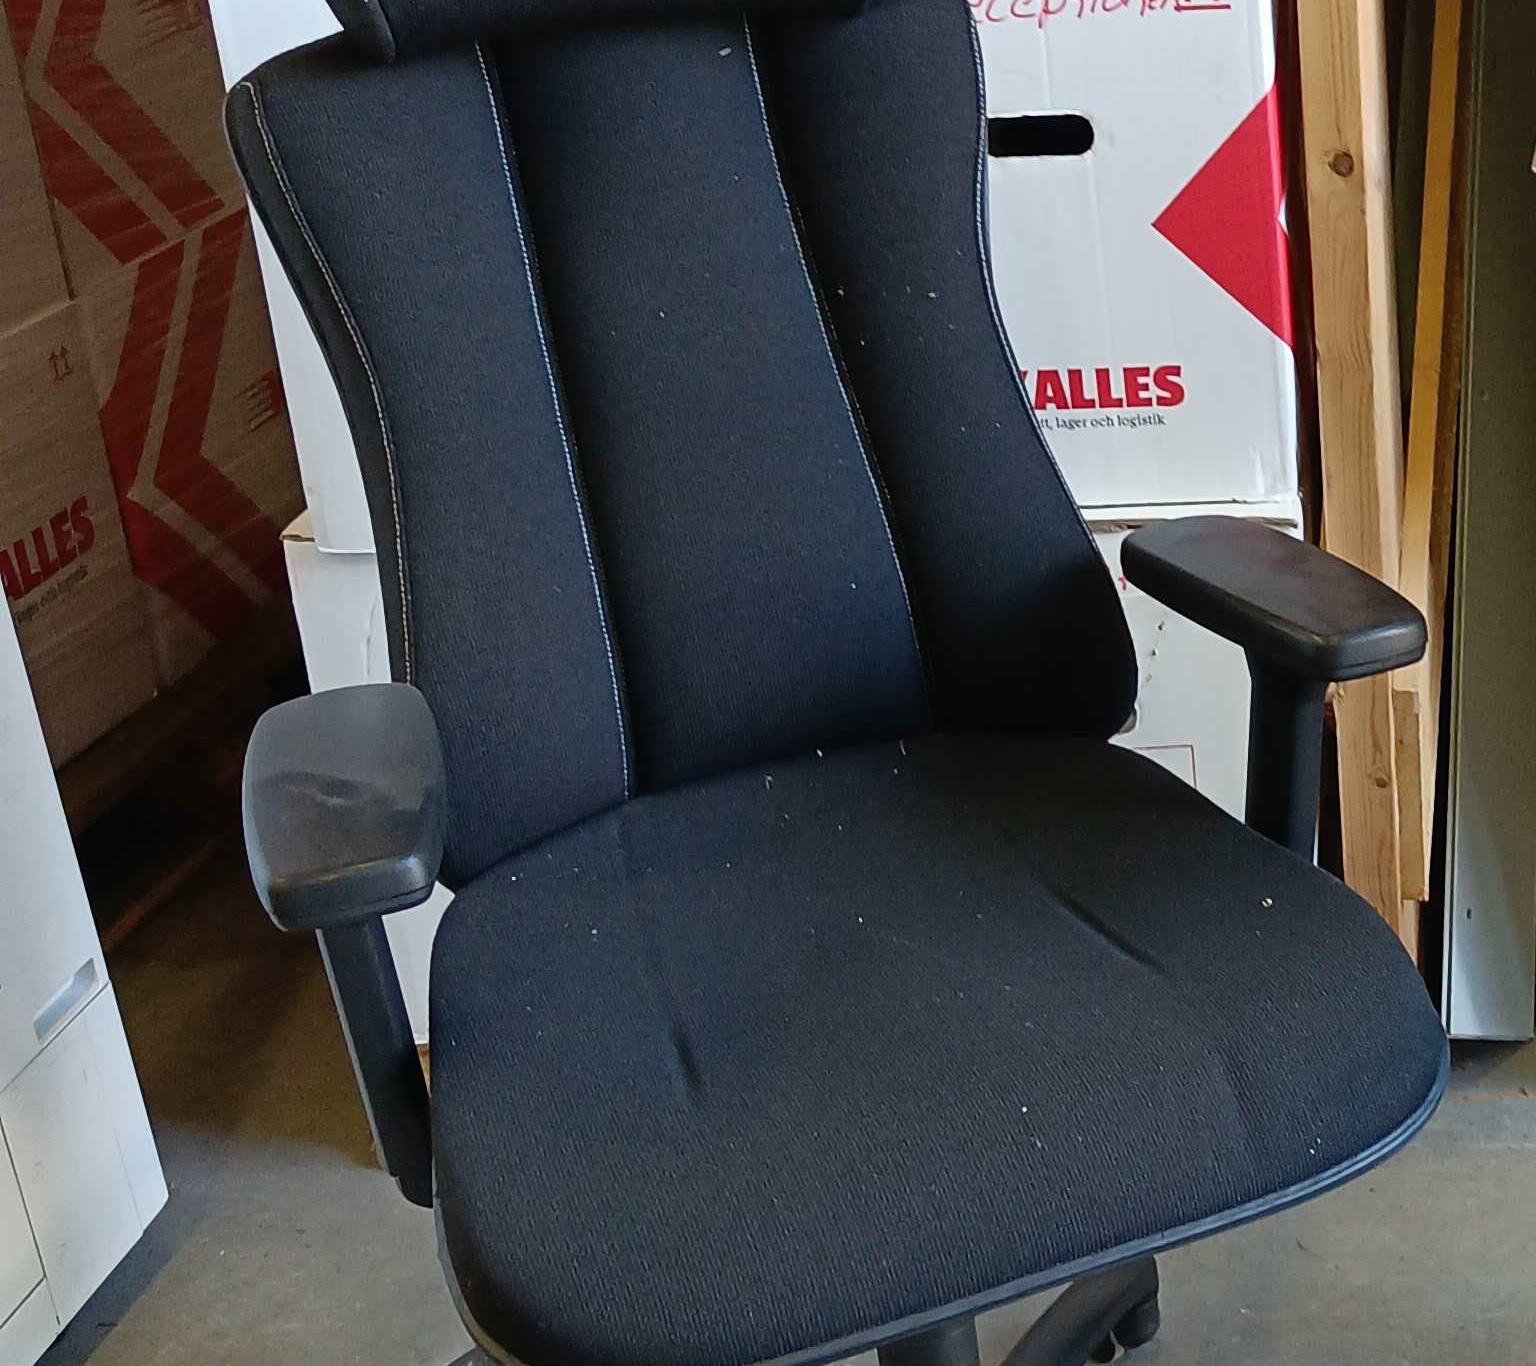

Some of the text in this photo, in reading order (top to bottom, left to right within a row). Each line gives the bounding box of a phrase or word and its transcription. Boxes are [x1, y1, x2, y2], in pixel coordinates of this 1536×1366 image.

[1019, 365, 1186, 411] ALLES
[1055, 416, 1088, 431] lager
[1090, 414, 1115, 428] och
[1117, 413, 1166, 429] logistik
